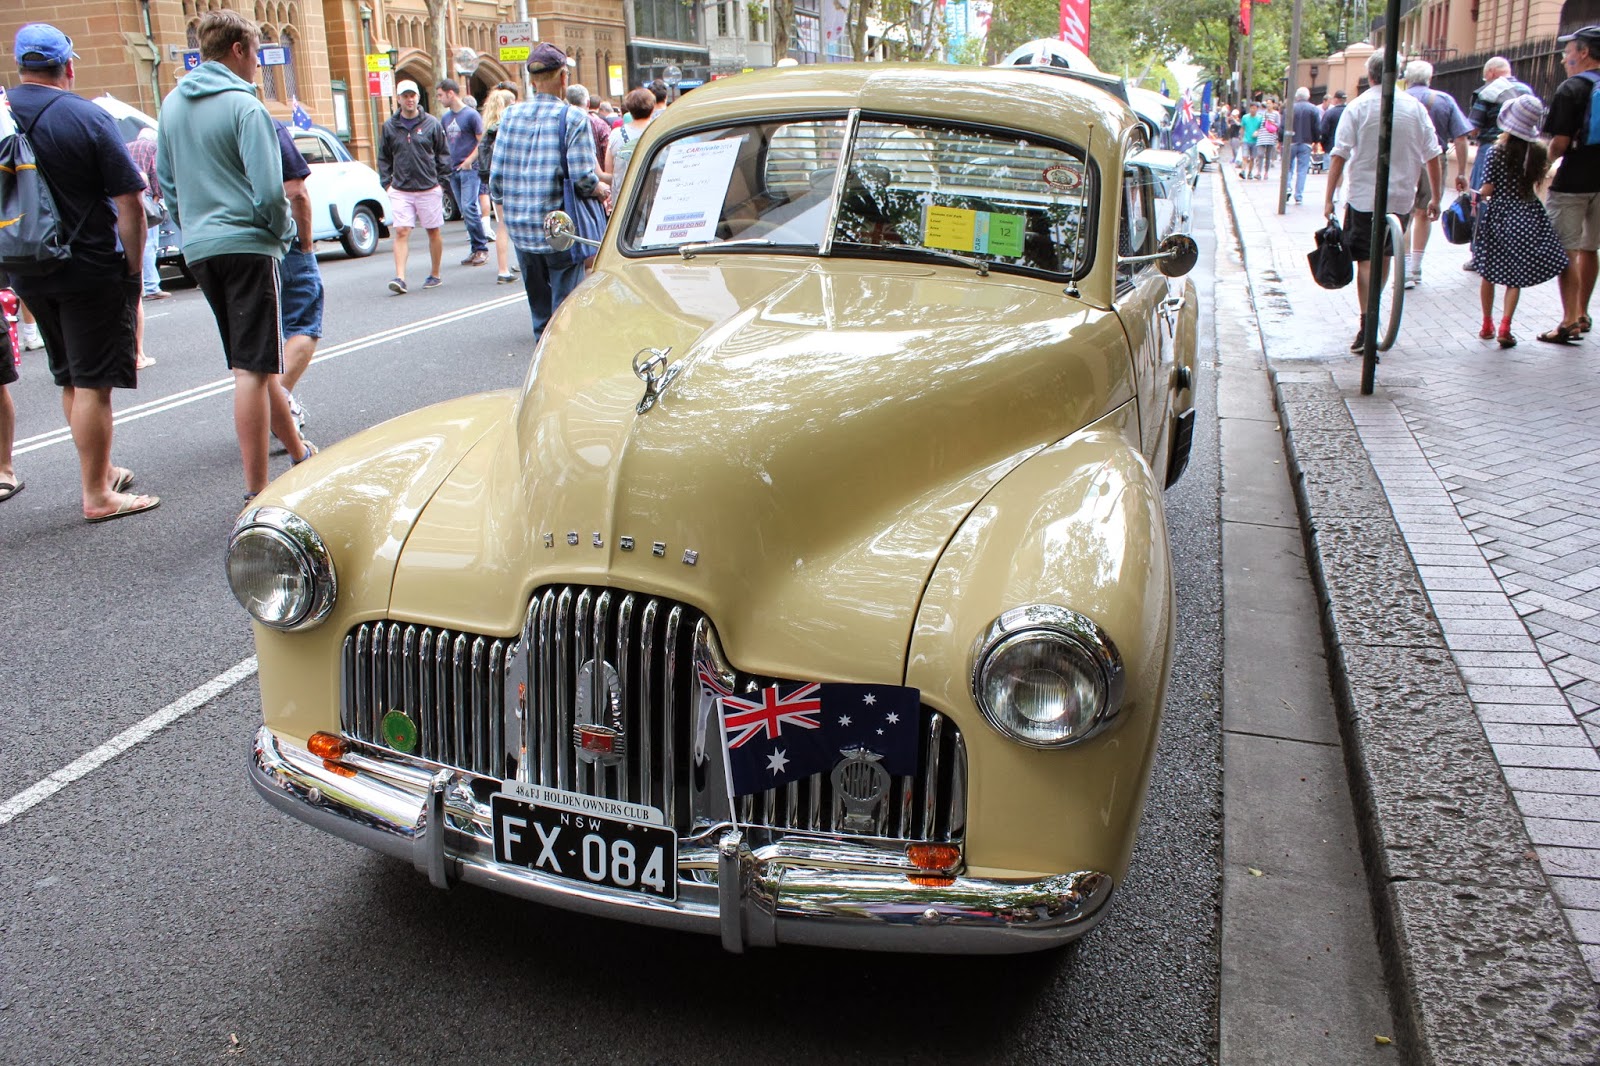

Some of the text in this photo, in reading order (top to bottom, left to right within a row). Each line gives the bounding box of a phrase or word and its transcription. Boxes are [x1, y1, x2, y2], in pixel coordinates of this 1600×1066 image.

[1000, 227, 1011, 237] 12
[543, 791, 581, 807] HOLDEN
[582, 797, 622, 815] OWNERS
[623, 806, 649, 820] CLUB
